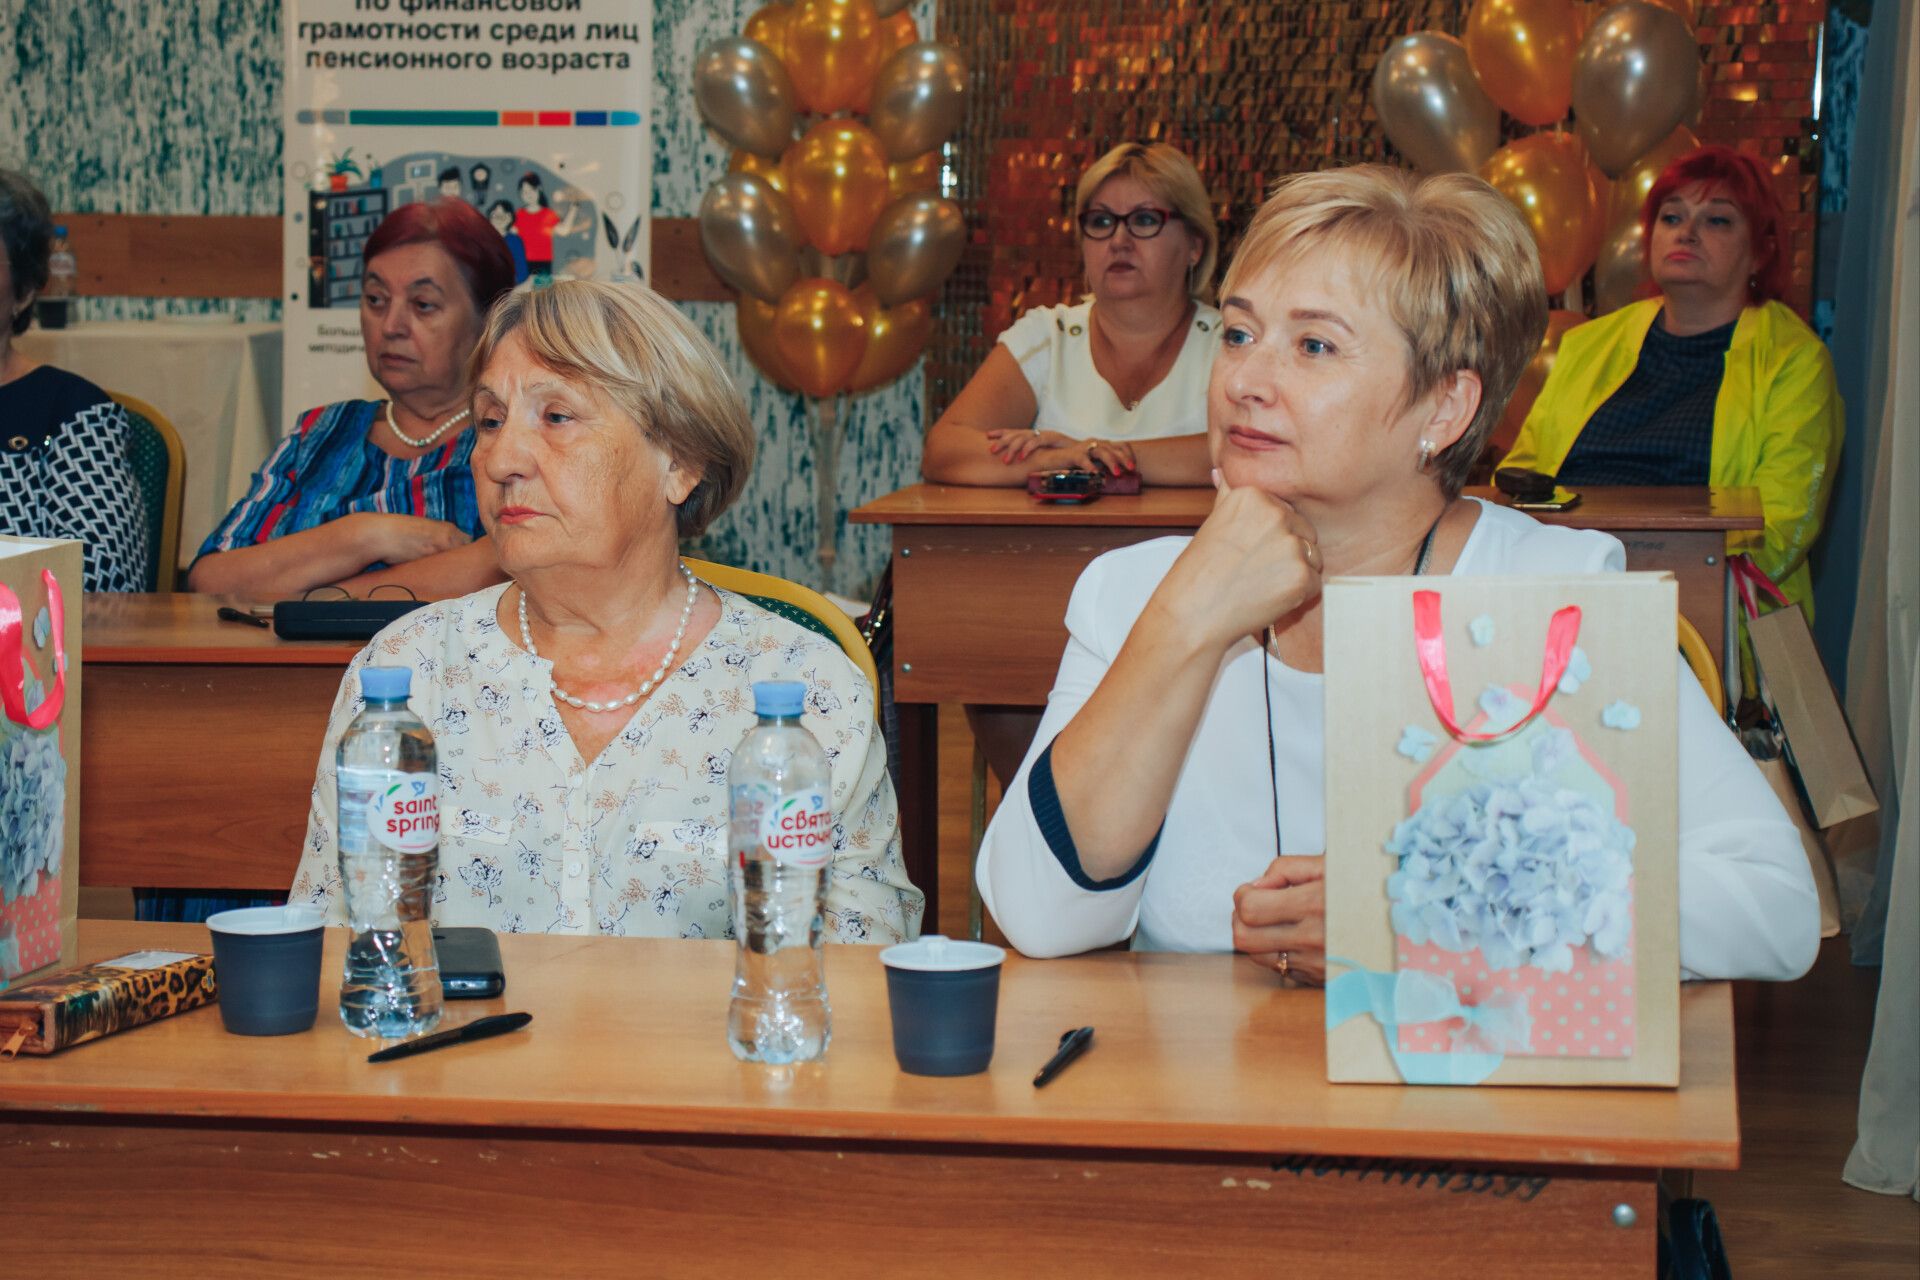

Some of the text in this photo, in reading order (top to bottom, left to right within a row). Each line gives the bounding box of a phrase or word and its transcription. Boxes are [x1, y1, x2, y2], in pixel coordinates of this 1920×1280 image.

[298, 22, 640, 43] грамотности среди лиц
[306, 51, 631, 73] пенсионного возраста
[393, 795, 437, 815] saint
